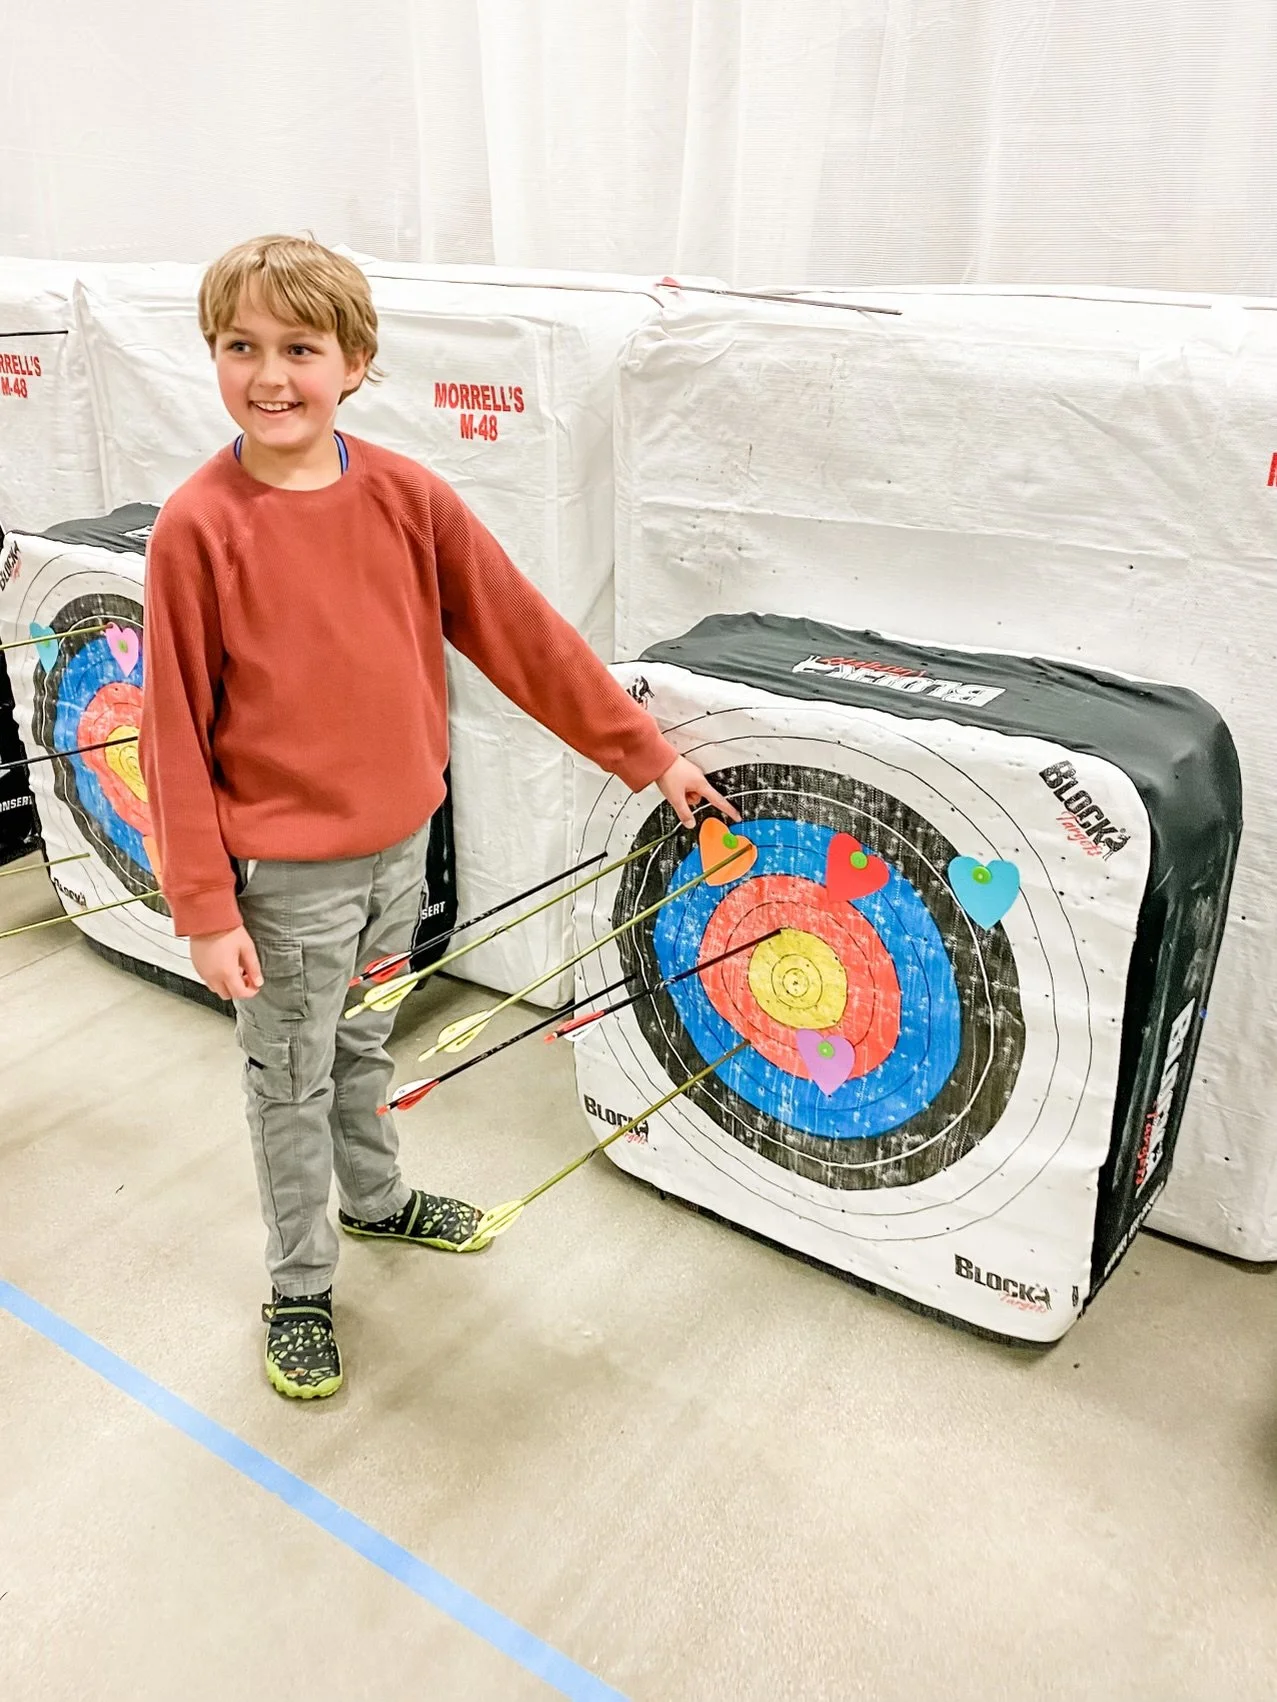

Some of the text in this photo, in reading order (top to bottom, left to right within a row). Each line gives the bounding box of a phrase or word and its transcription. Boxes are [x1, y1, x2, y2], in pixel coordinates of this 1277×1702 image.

[434, 382, 525, 413] MORRELL'S
[460, 413, 498, 441] M-48
[1039, 760, 1119, 846] BLOCK
[421, 901, 446, 920] SERT
[954, 1253, 1036, 1304] BLOCK
